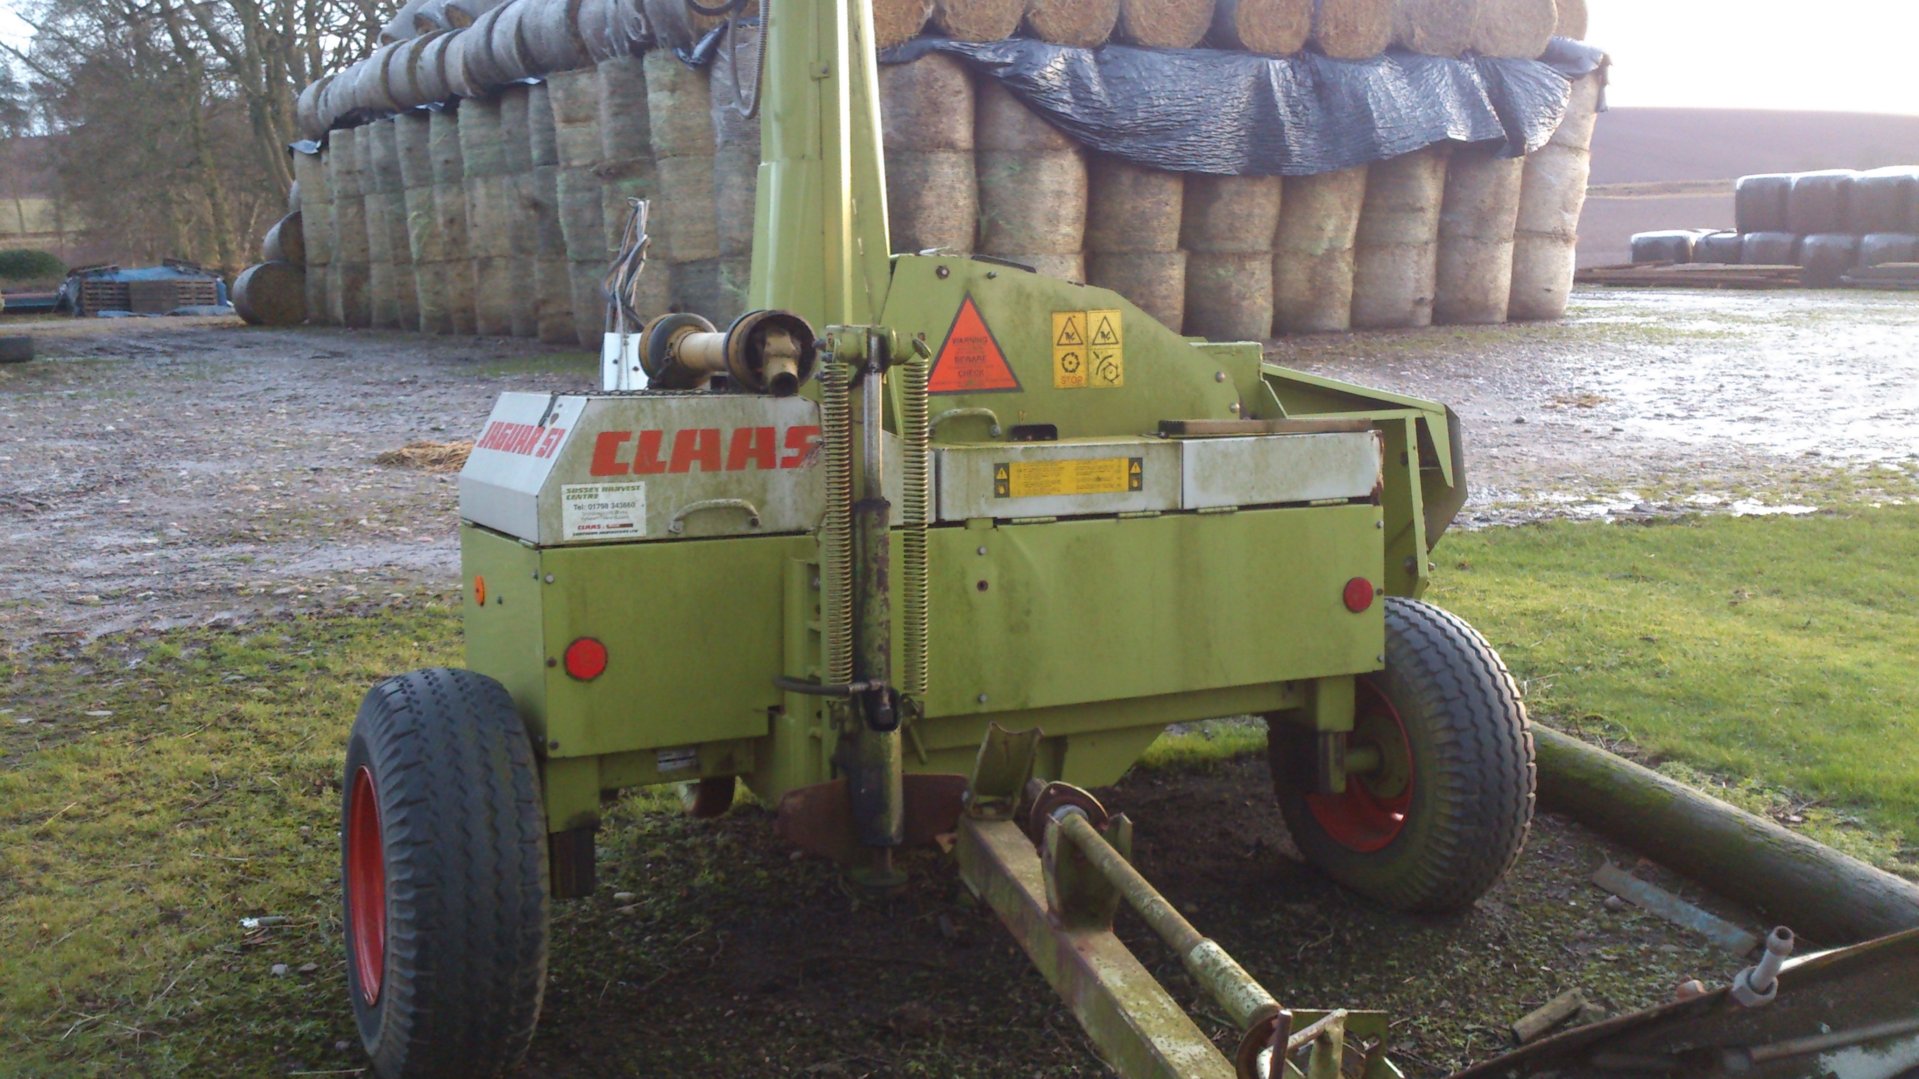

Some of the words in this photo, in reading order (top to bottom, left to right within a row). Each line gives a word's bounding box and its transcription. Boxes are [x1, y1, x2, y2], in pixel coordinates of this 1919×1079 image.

[1060, 375, 1083, 385] STOP
[477, 420, 546, 456] JAGUAR
[590, 425, 821, 477] CLAAS
